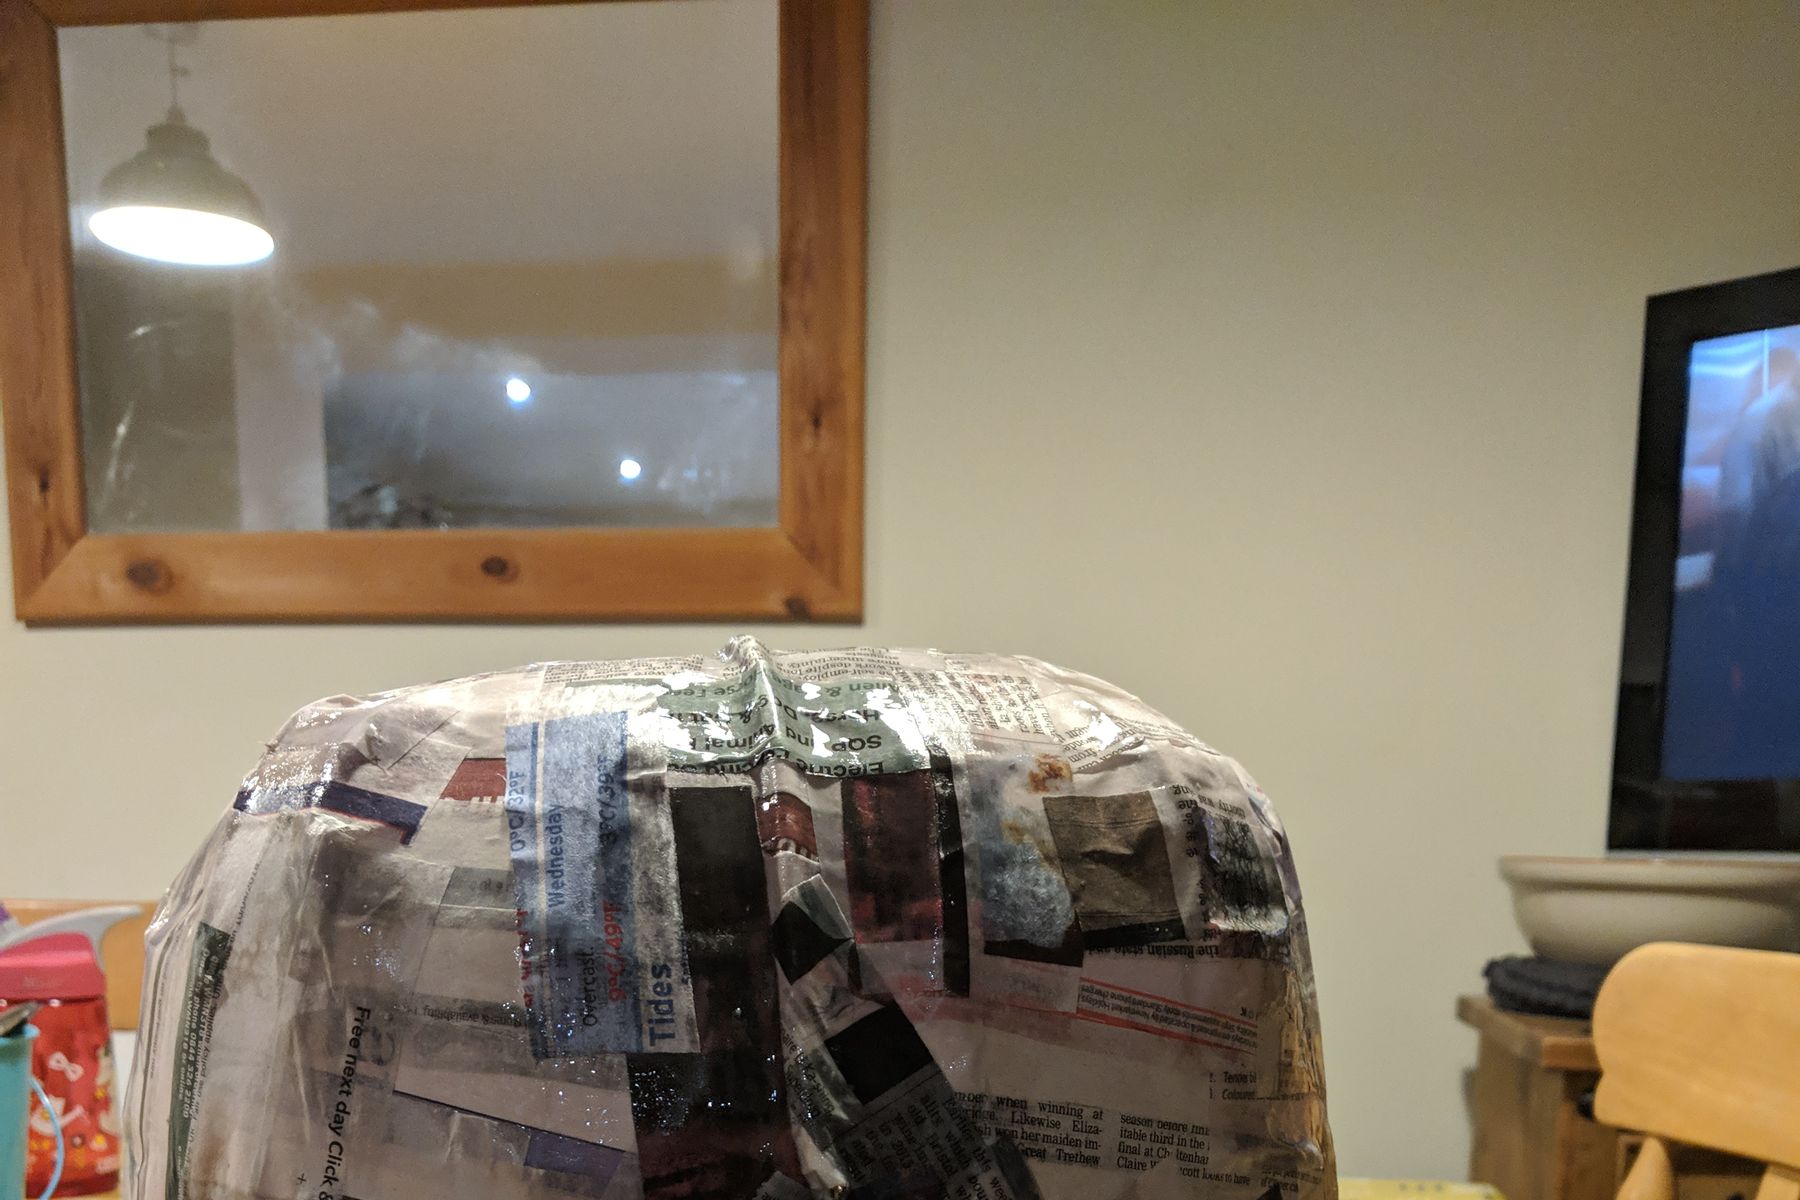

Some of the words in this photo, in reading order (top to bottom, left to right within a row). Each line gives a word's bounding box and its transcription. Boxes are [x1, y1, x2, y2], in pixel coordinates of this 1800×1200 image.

[831, 734, 881, 753] SQP
[546, 803, 565, 908] Wednesday
[579, 945, 598, 1027] Overcast.
[648, 962, 675, 1047] Tides
[345, 1005, 372, 1050] Free
[335, 1052, 359, 1097] next
[325, 1099, 353, 1137] day
[1010, 1110, 1061, 1130] Likewise
[1071, 1119, 1103, 1136] Eliza-
[1036, 1098, 1084, 1120] winning
[1092, 1107, 1104, 1120] at
[1020, 1129, 1040, 1142] her
[1041, 1131, 1083, 1148] maiden
[1083, 1137, 1101, 1151] im-
[1117, 1140, 1142, 1155] final
[1144, 1144, 1153, 1156] at
[1119, 1125, 1148, 1142] itable
[1148, 1129, 1175, 1145] third
[1176, 1134, 1188, 1147] in
[318, 1138, 347, 1187] Click
[1115, 1155, 1148, 1172] Claire
